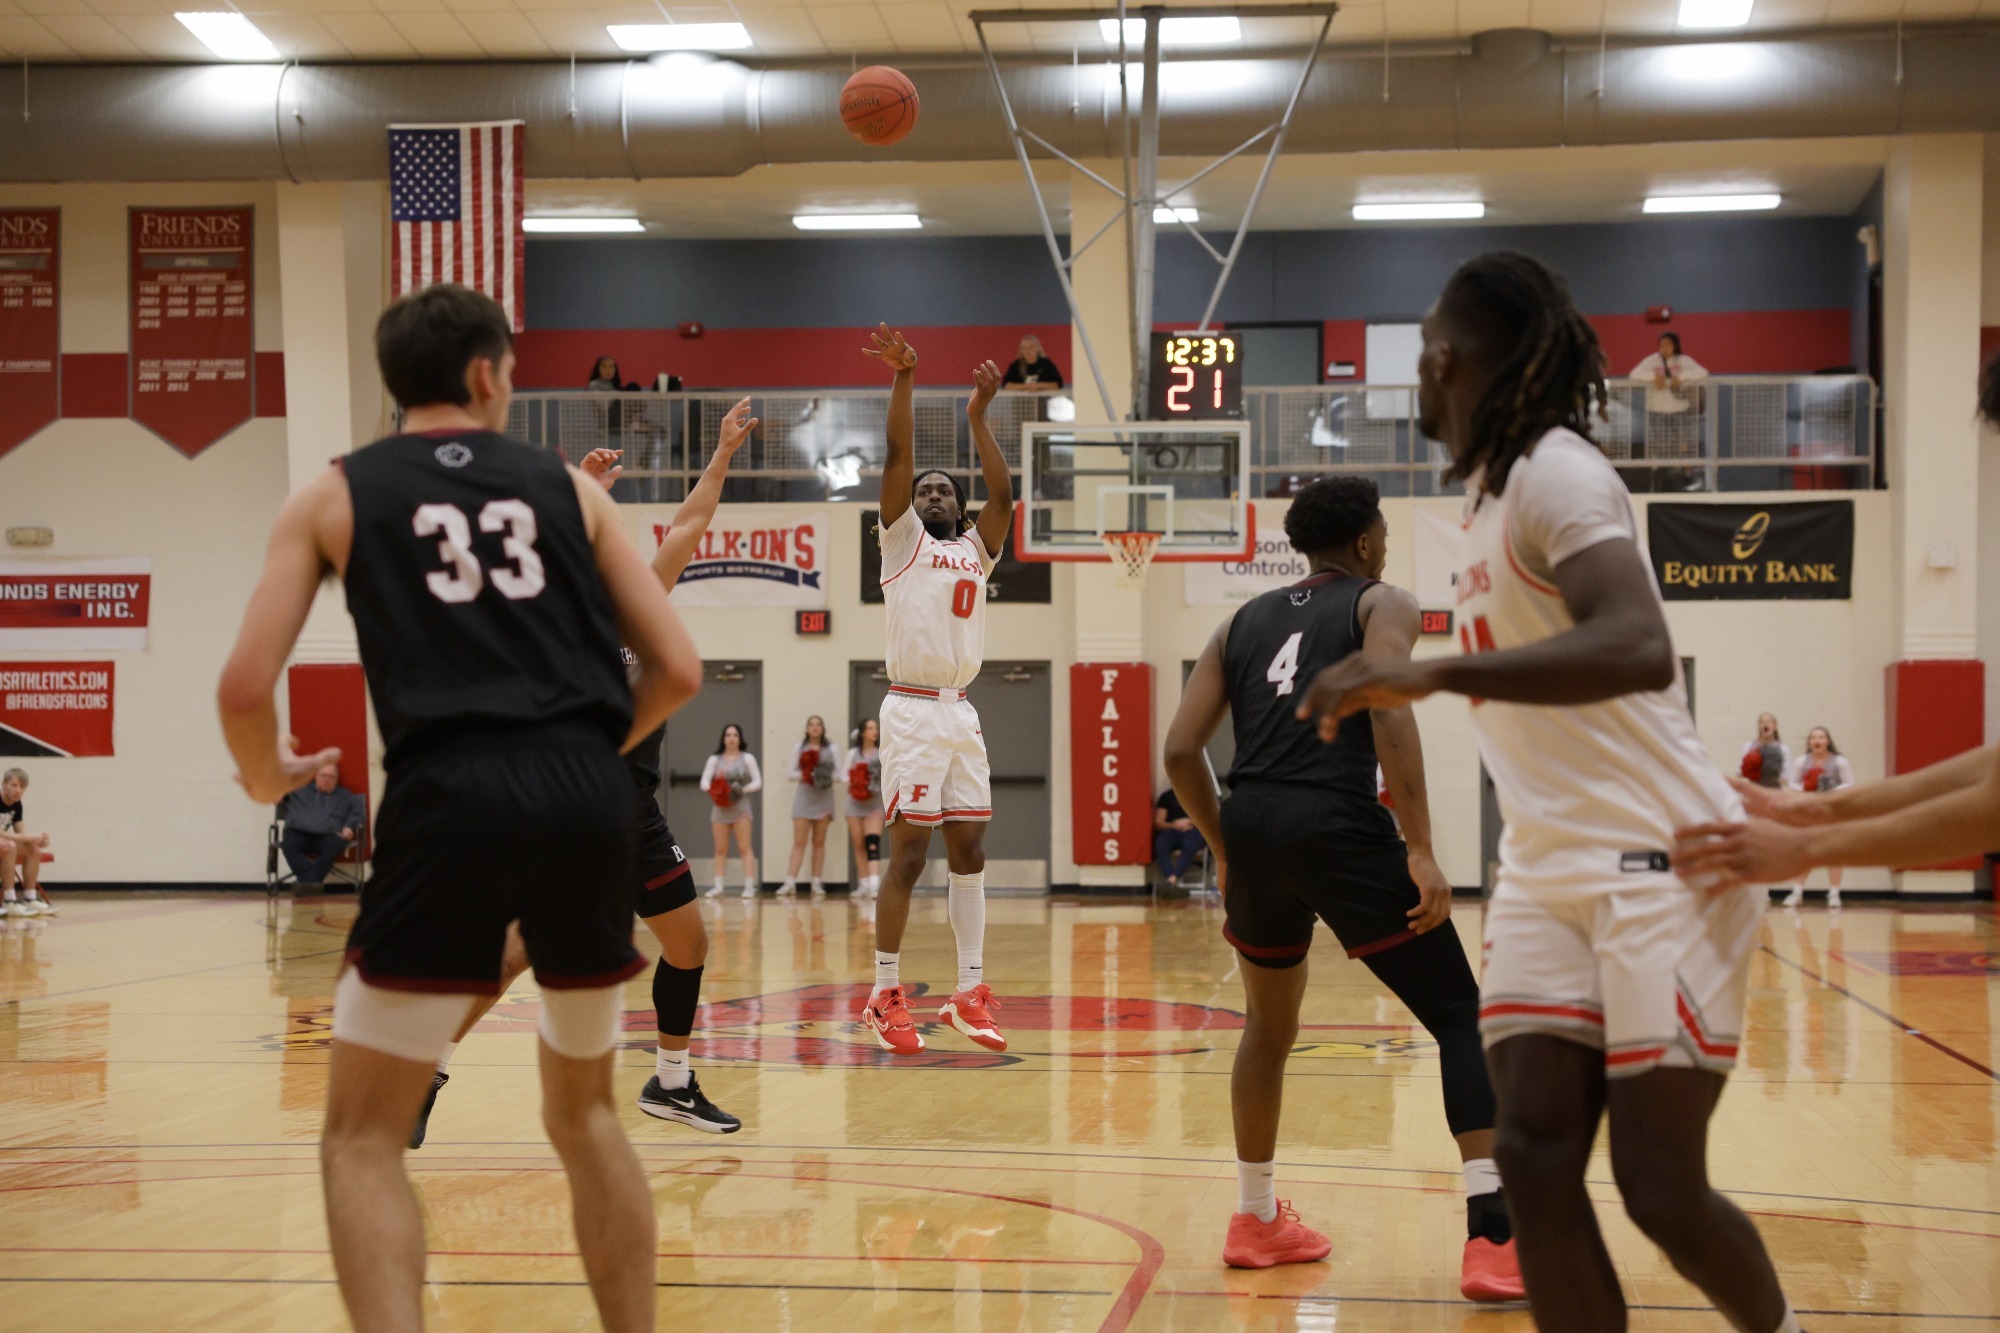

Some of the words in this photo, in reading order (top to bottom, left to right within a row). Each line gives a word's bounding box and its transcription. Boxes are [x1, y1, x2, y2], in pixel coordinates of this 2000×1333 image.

[141, 214, 240, 234] FRIENDS
[141, 234, 241, 247] UNIVERSITY
[1166, 338, 1235, 365] 12:37
[1167, 366, 1222, 411] 21
[412, 499, 546, 603] 33
[1222, 558, 1305, 576] Controls
[1664, 561, 1759, 587] EQUITY
[1766, 560, 1840, 583] BANK
[54, 583, 140, 600] ENERGY
[952, 578, 977, 619] 0
[87, 602, 135, 618] INC.
[801, 612, 826, 632] EXIT
[1422, 612, 1449, 632] EXIT
[1266, 632, 1303, 697] 4
[5, 692, 109, 711] @FRIENDSFALCONS
[1101, 669, 1121, 861] FALCONS
[909, 784, 929, 803] F
